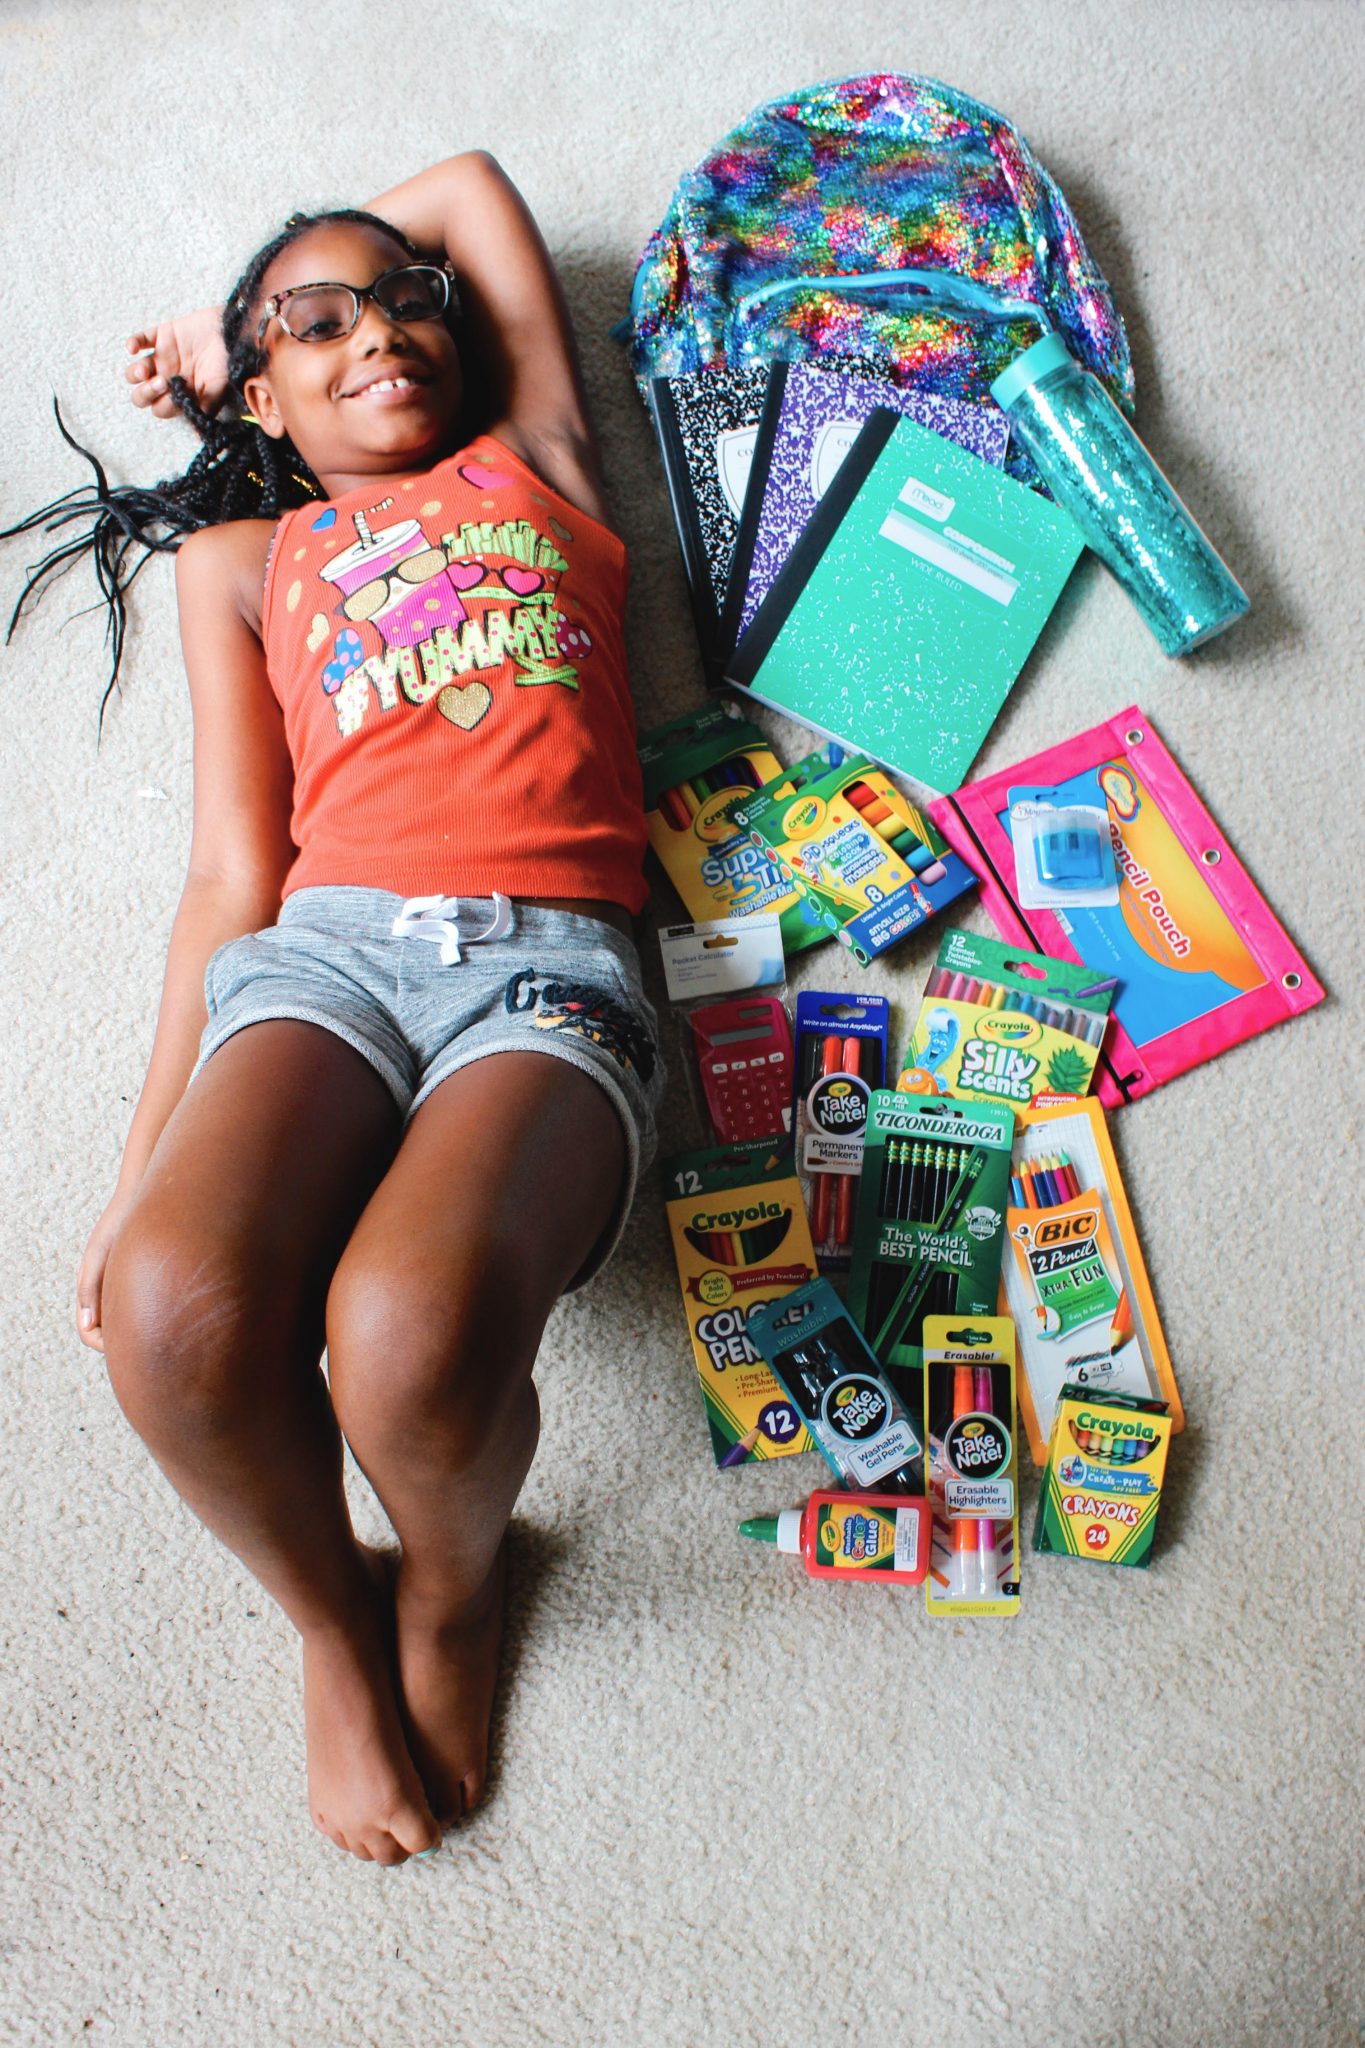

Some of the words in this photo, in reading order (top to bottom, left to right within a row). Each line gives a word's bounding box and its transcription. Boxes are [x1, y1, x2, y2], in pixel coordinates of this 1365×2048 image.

[911, 557, 933, 575] WIDE
[935, 571, 962, 591] RULED
[734, 811, 749, 826] 8
[788, 802, 815, 829] Crayola
[729, 890, 777, 918] Washable
[778, 884, 793, 899] Ma
[865, 884, 885, 904] 8
[861, 911, 877, 923] Unique
[881, 898, 895, 910] Bright
[892, 889, 907, 901] Colors
[1142, 888, 1189, 956] Pouch
[870, 930, 891, 947] BIG
[952, 934, 966, 948] 12
[672, 954, 698, 966] Pocket
[697, 951, 734, 962] Calculator
[945, 956, 972, 969] Crayons
[828, 1021, 849, 1029] almost
[987, 1020, 1031, 1031] Crayola
[964, 1040, 1037, 1081] Silly
[818, 1095, 861, 1112] Take
[877, 1095, 891, 1107] 10
[820, 1104, 866, 1125] Note!
[875, 1112, 1003, 1141] TICONDEROGA
[733, 1138, 779, 1153] Pre-Sharpened
[812, 1140, 865, 1152] Permanent
[819, 1149, 858, 1160] Markers
[674, 1170, 703, 1195] 12
[692, 1201, 783, 1233] Crayola
[885, 1227, 913, 1243] The
[917, 1230, 969, 1250] World's
[879, 1241, 917, 1259] BEST
[919, 1246, 973, 1267] PENCIL
[1050, 1239, 1095, 1270] Pencil
[708, 1285, 724, 1293] Bold
[736, 1275, 767, 1286] Preferred
[776, 1272, 805, 1280] Teachers!
[706, 1292, 728, 1300] Colors
[944, 1351, 994, 1361] Erasable!
[1078, 1367, 1089, 1382] 6
[743, 1386, 778, 1398] Premium
[832, 1390, 873, 1424] Take
[842, 1393, 886, 1438] Note!
[765, 1409, 795, 1435] 12
[1076, 1411, 1155, 1440] Crayola
[857, 1432, 903, 1463] Washable
[952, 1435, 995, 1455] Take
[866, 1455, 882, 1469] Gel
[881, 1442, 905, 1460] Pens
[955, 1442, 1003, 1469] Note!
[956, 1485, 999, 1494] Erasable
[1122, 1478, 1142, 1487] PLAY
[949, 1496, 1007, 1507] Highlighters
[1062, 1496, 1140, 1527] CRAYONS
[844, 1518, 853, 1555] Washable
[852, 1515, 865, 1559] Color
[865, 1519, 878, 1556] Glue
[1088, 1529, 1107, 1545] 24
[1007, 1585, 1013, 1594] 2
